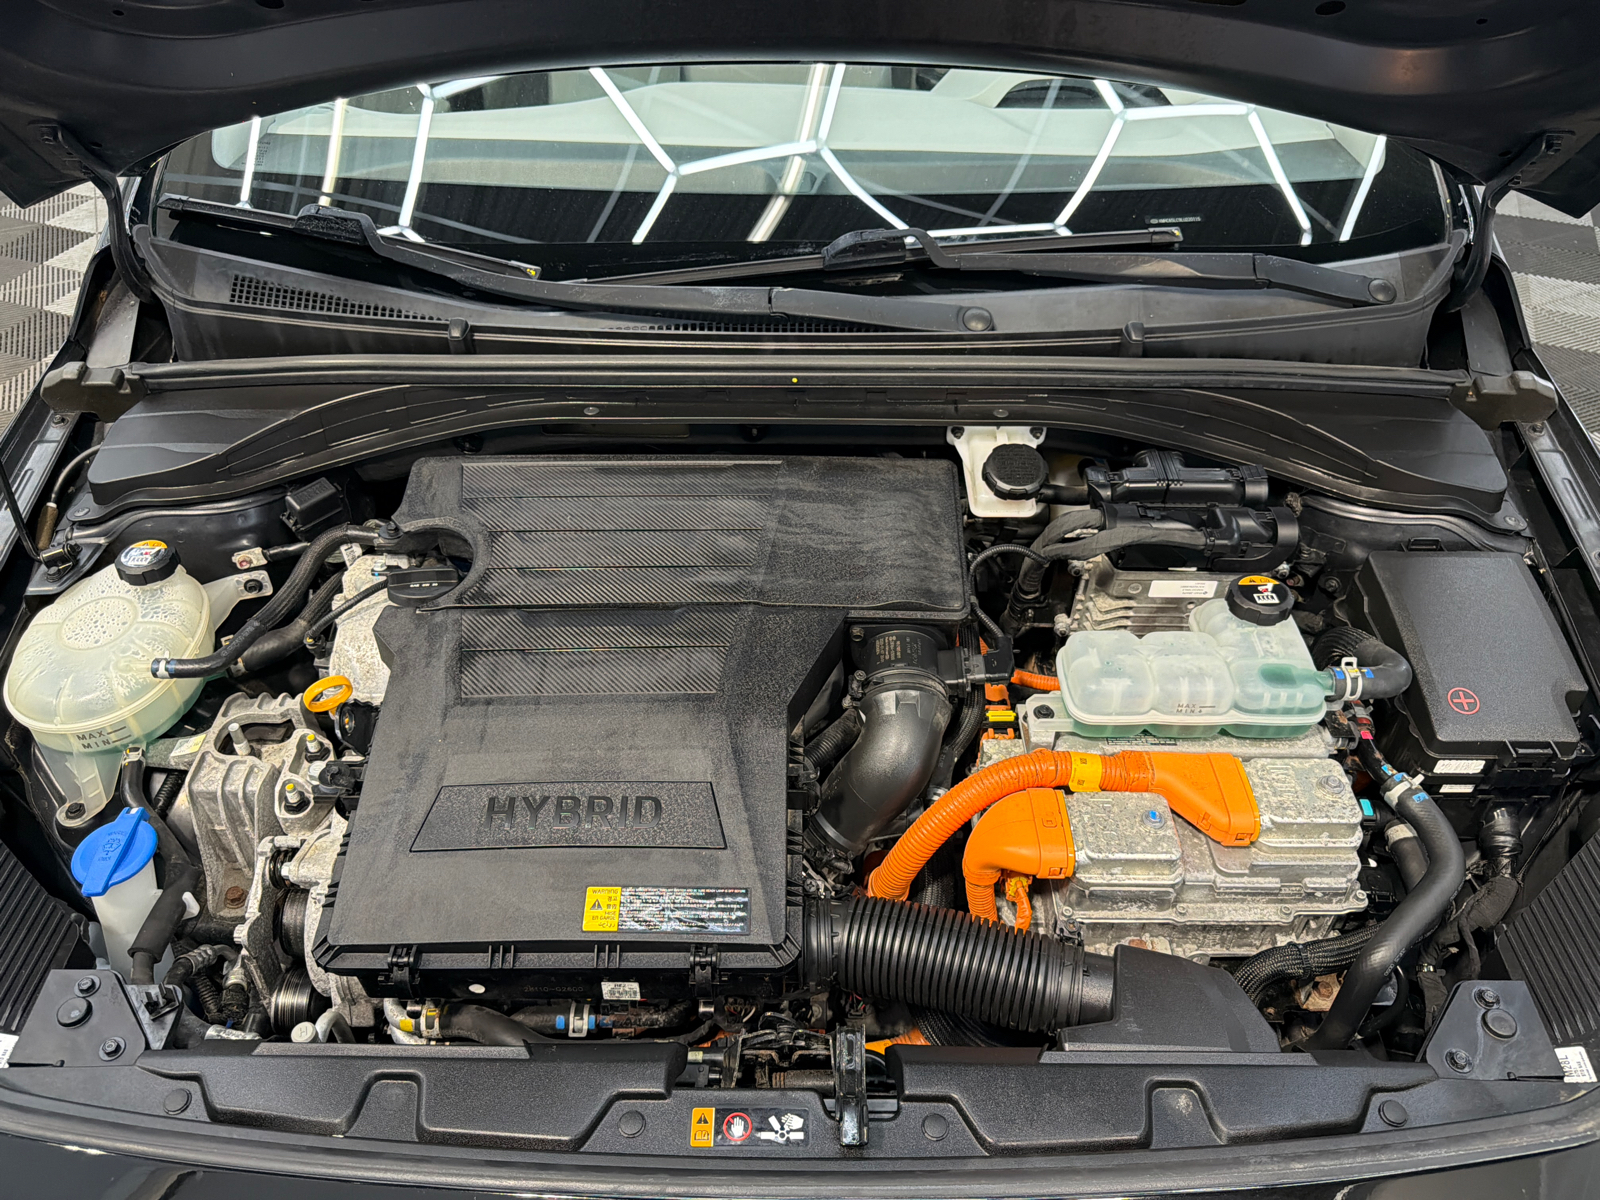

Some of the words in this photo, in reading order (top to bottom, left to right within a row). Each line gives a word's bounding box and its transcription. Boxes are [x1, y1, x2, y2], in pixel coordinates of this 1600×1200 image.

[76, 730, 106, 741] MAX
[81, 738, 111, 750] MIN
[482, 796, 662, 830] HYBRID
